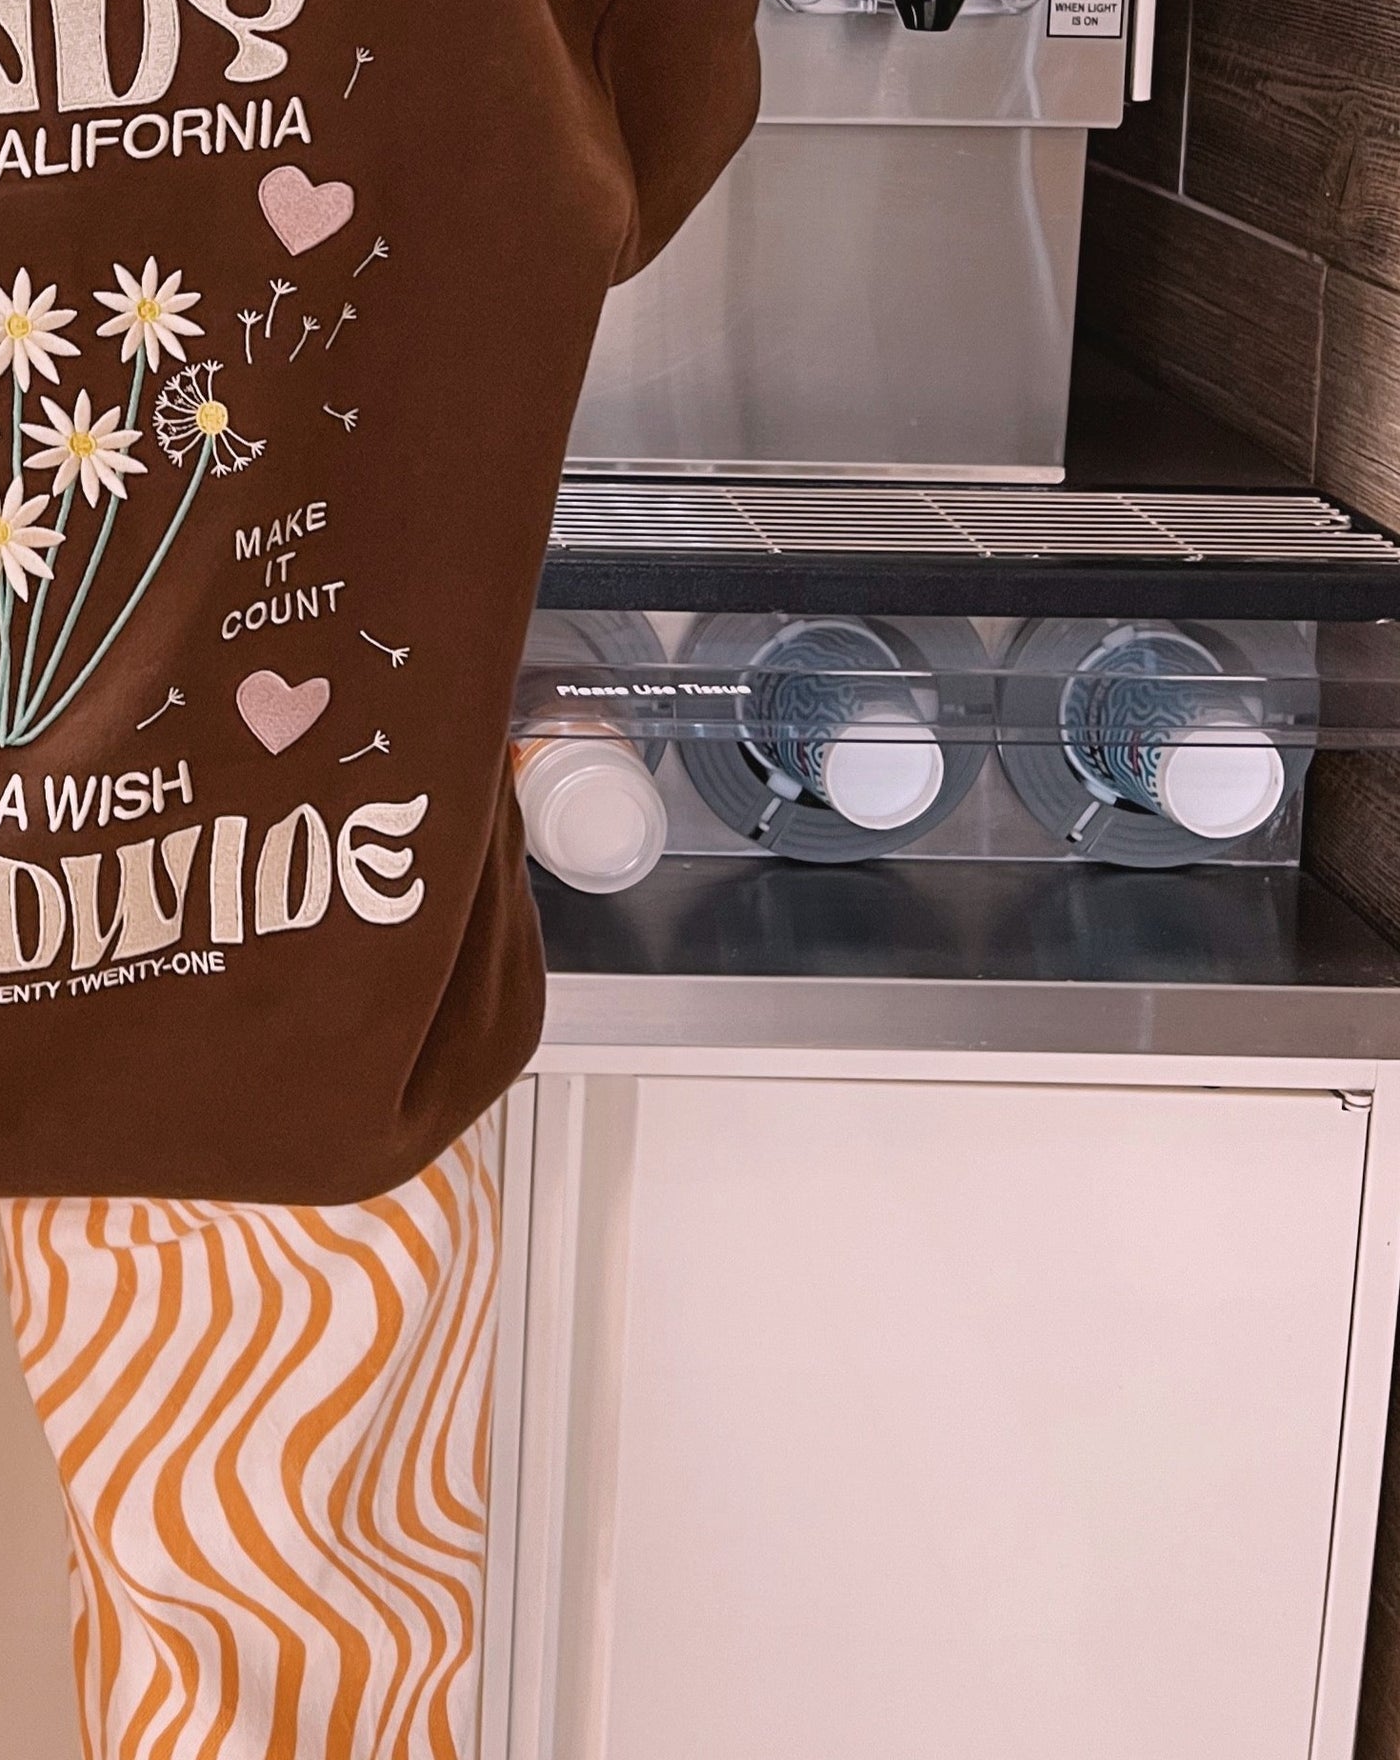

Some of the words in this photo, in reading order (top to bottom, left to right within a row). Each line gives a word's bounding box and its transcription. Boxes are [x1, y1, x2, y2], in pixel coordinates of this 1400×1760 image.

[1055, 3, 1085, 12] WHEN
[1087, 3, 1117, 13] LIGHT
[1072, 16, 1081, 26] IS
[1084, 16, 1098, 26] ON
[233, 500, 329, 561] MAKE
[264, 552, 297, 588] IT
[220, 580, 346, 641] COUNT
[556, 685, 630, 696] Please
[633, 685, 677, 695] Use
[678, 684, 752, 695] Tissue
[43, 759, 195, 833] WISH
[66, 949, 227, 996] TWENTY-ONE
